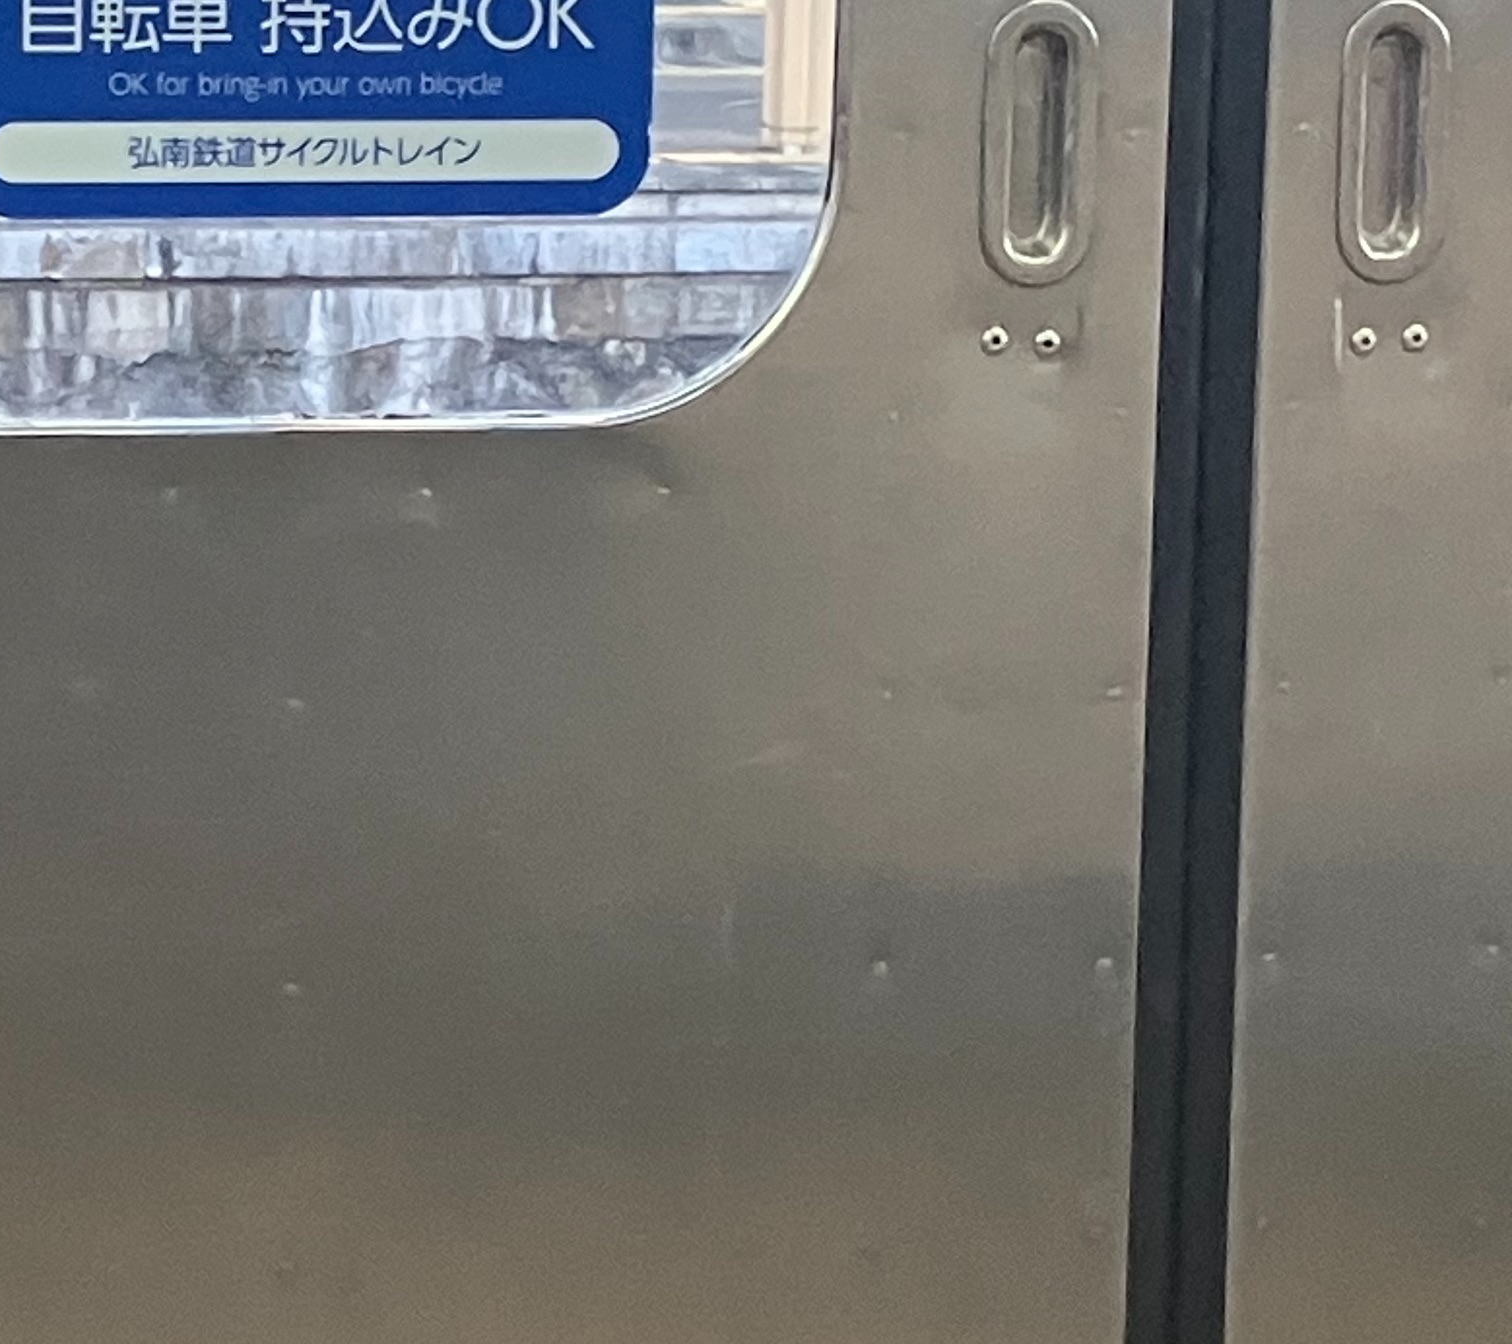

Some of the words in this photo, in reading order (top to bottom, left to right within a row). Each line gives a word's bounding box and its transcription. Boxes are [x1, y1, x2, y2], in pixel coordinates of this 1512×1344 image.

[108, 72, 148, 96] OK
[156, 72, 188, 96] for
[198, 72, 288, 103] bring-in
[297, 77, 349, 101] your
[358, 76, 412, 96] own
[420, 71, 504, 100] bicycle
[127, 135, 483, 171] 弘南鉄道サイクルトレイン
